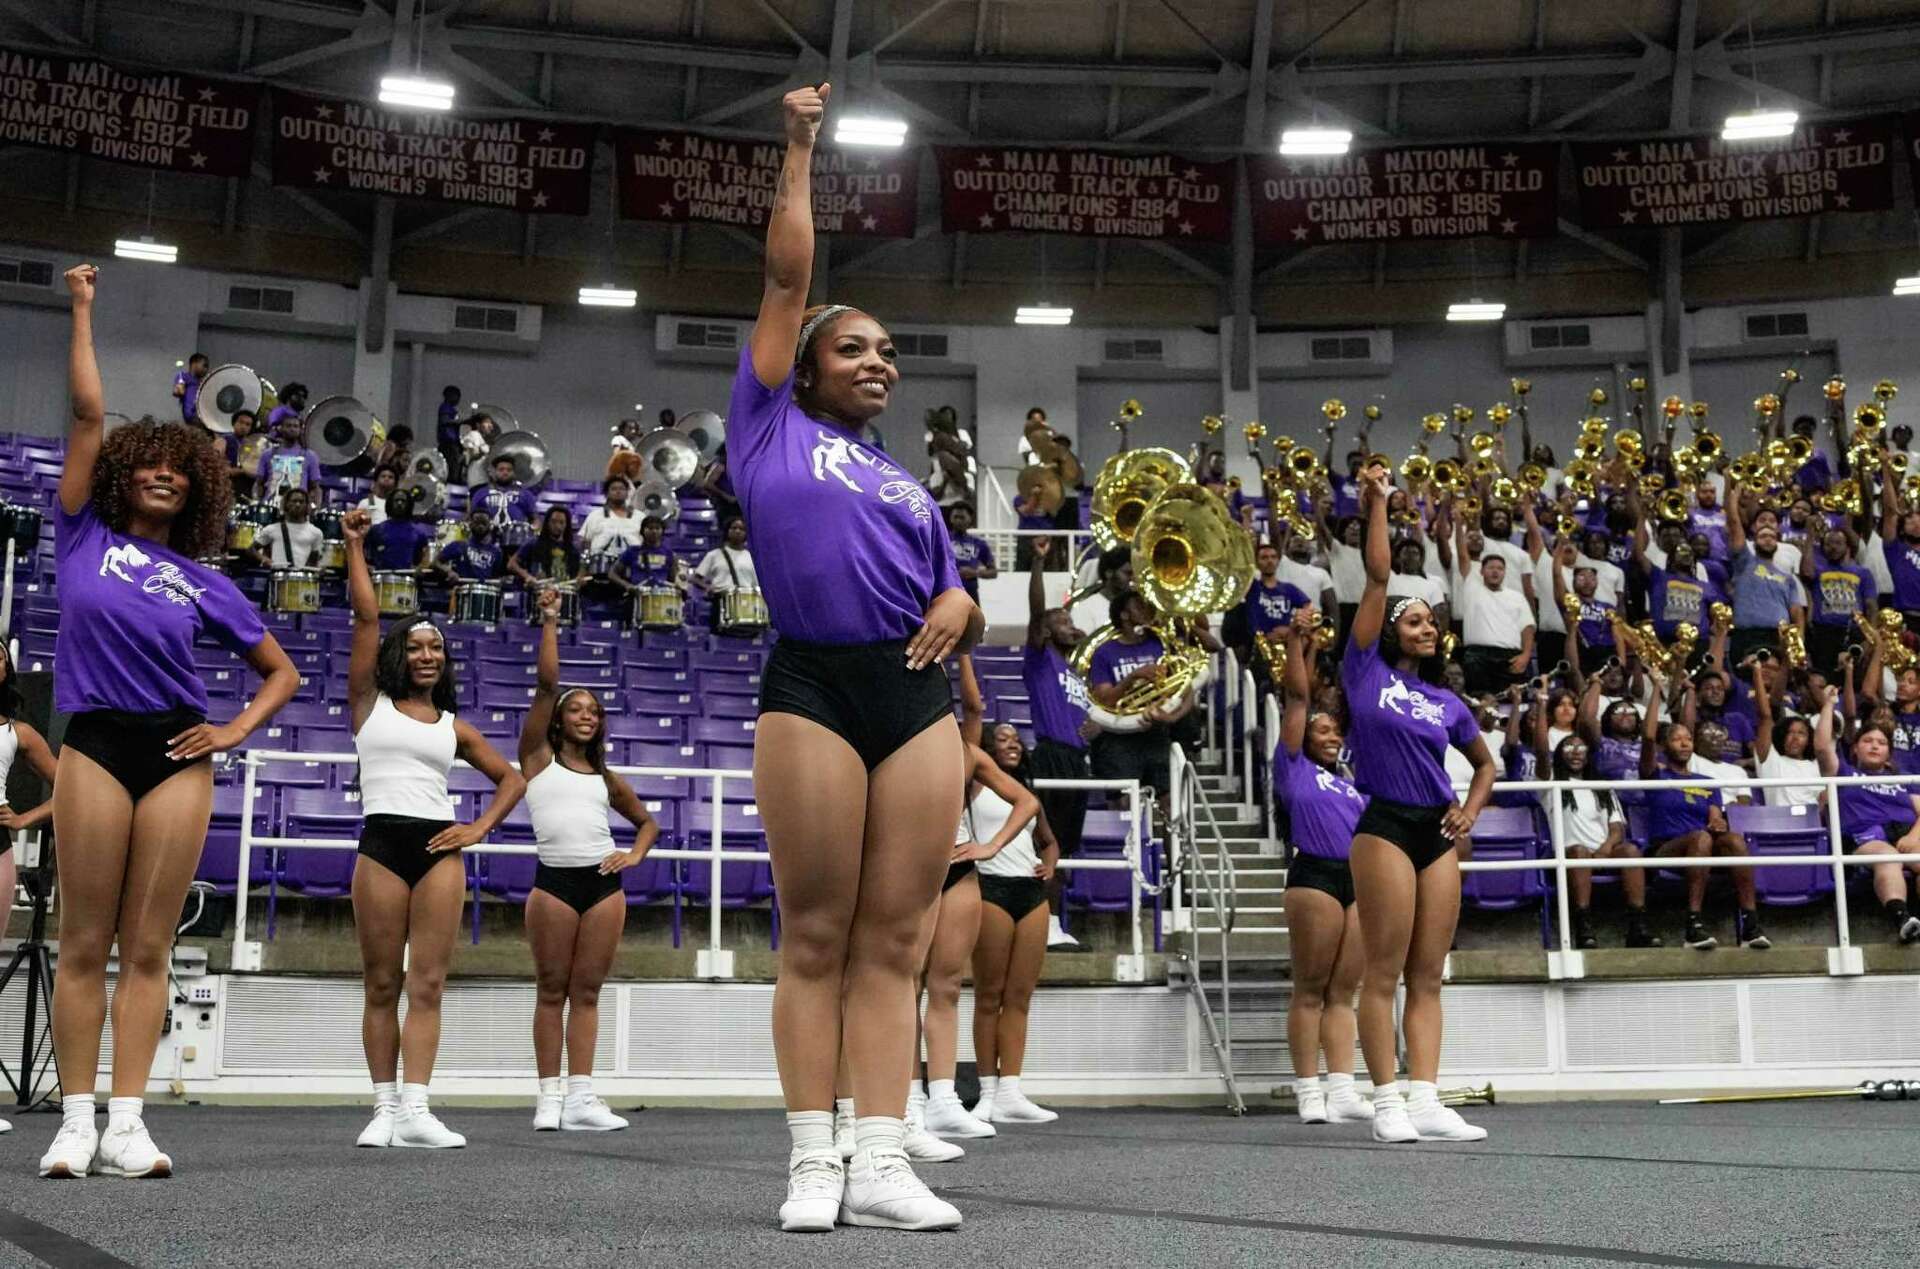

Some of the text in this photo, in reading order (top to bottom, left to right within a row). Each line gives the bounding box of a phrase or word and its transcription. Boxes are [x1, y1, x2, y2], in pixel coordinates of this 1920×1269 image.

[67, 62, 184, 101] NATIONAL
[47, 82, 122, 115] TRACK
[130, 96, 180, 122] AND
[186, 104, 248, 130] FIELD
[344, 103, 525, 143] NAIA NATIONAL
[91, 136, 174, 165] DIVISION
[280, 116, 585, 170] OUTDOOR TRACK AND FIELD
[684, 137, 739, 161] NAIA
[1640, 141, 1695, 164] NAIA
[635, 153, 711, 180] INDOOR
[719, 163, 776, 188] TRAC
[846, 173, 901, 194] FIELD
[1004, 151, 1176, 177] NAIA NATIONAL
[1384, 147, 1490, 172] NATIONAL
[1582, 162, 1686, 188] OUTDOOR
[1694, 155, 1766, 181] TRACK
[1774, 149, 1820, 175] AND
[1825, 143, 1885, 170] FIELD
[442, 182, 517, 207] DIVISION
[953, 169, 1219, 203] OUTDOOR TRACK & FIELD
[1264, 168, 1543, 201] OUTDOOR TRACK & FIELD
[1629, 171, 1838, 207] CHAMPIONS 1986
[1742, 194, 1823, 219] DIVISION
[1093, 218, 1165, 237] DIVISION
[1411, 216, 1489, 237] DIVISION
